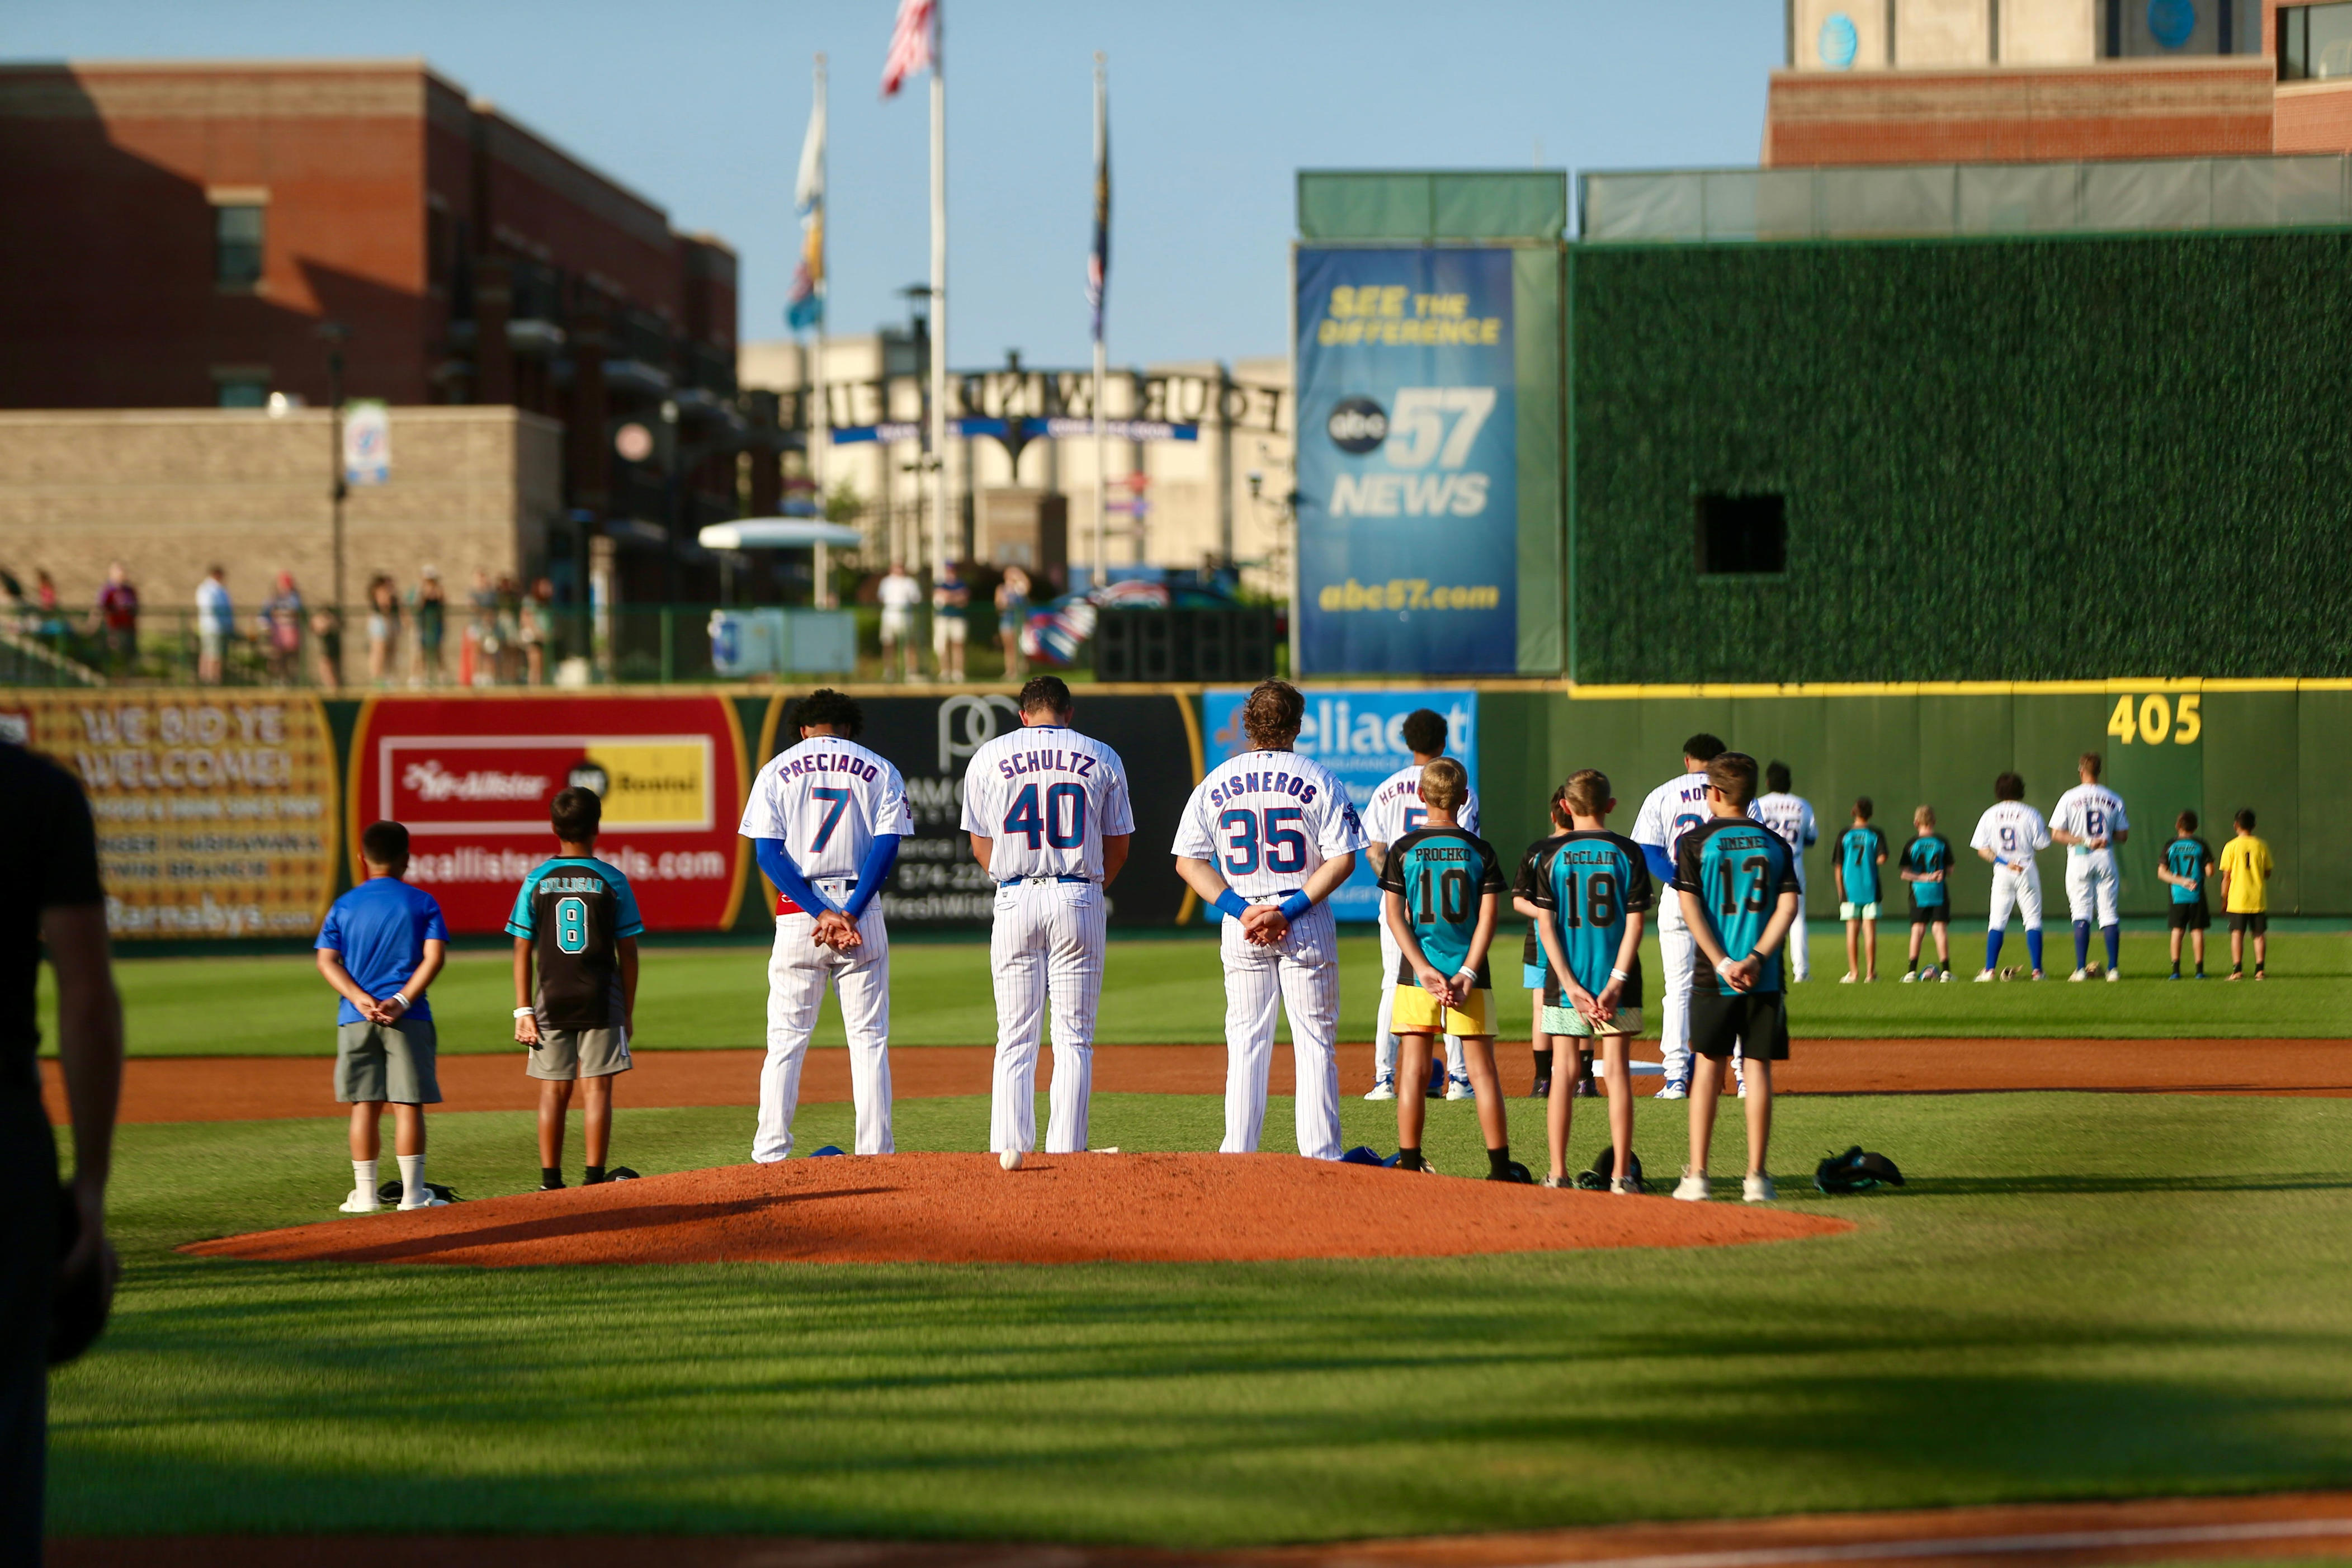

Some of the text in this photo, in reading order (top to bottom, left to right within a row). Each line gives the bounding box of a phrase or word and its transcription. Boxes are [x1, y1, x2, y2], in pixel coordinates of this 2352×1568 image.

[1330, 285, 1468, 318] SEE THE
[1317, 318, 1501, 346] DIFFERENCE
[1329, 387, 1497, 469] abc 57
[1329, 473, 1490, 517] NEWS
[1319, 579, 1500, 611] abc57.com
[80, 706, 150, 747] WE
[2108, 694, 2202, 745] 405
[77, 747, 291, 789] WELCOME!
[778, 754, 878, 784] PRECIADO
[999, 750, 1096, 779] SCHULTZ
[1211, 772, 1317, 807] SISNEROS
[809, 787, 851, 853] 7
[1003, 782, 1087, 850] 40
[2086, 810, 2105, 837] 8
[1220, 807, 1307, 876] 35
[1415, 848, 1471, 863] PROCHKO
[1853, 845, 1865, 865] 7
[2000, 827, 2016, 852] 9
[1562, 851, 1618, 865] McCLAIN
[2173, 854, 2195, 877] 17
[2245, 851, 2251, 869] 1
[1419, 868, 1470, 924] 10
[1566, 871, 1617, 928] 18
[1720, 856, 1770, 915] 13
[555, 896, 589, 954] 8
